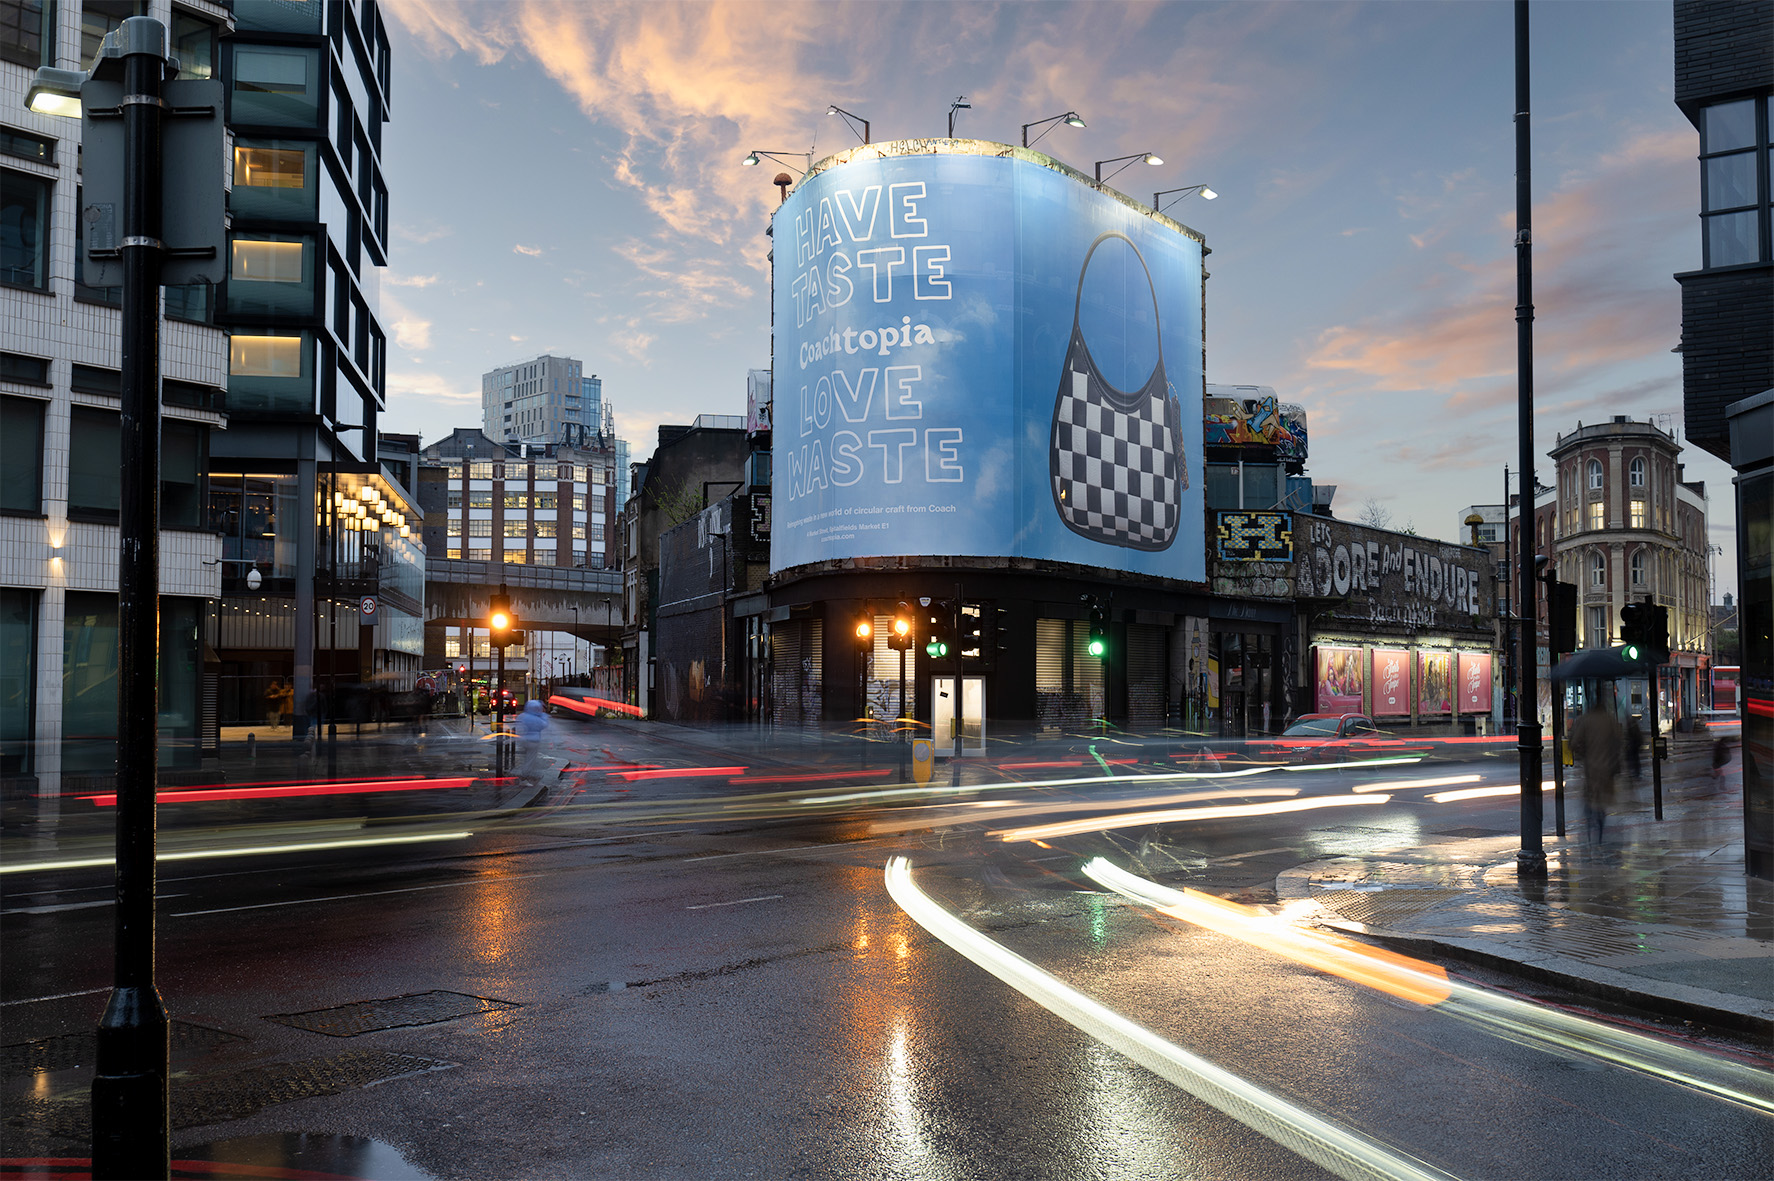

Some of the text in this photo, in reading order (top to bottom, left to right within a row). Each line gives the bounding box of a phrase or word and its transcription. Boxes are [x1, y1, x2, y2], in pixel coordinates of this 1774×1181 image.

[796, 181, 928, 267] HAVE
[791, 245, 952, 328] TASTE
[800, 316, 935, 370] Coachtopia
[801, 365, 922, 437] LOVE
[788, 428, 963, 501] WASTE
[844, 507, 852, 515] of
[854, 506, 884, 515] circular
[885, 505, 905, 514] craft
[906, 504, 927, 513] from
[928, 504, 957, 513] Coach
[859, 523, 880, 531] Market
[881, 522, 890, 530] E1
[1310, 521, 1332, 548] LETS
[363, 602, 374, 611] 20
[1298, 541, 1380, 597] ADORE
[1382, 542, 1403, 575] And
[1403, 547, 1480, 616] ENDURE
